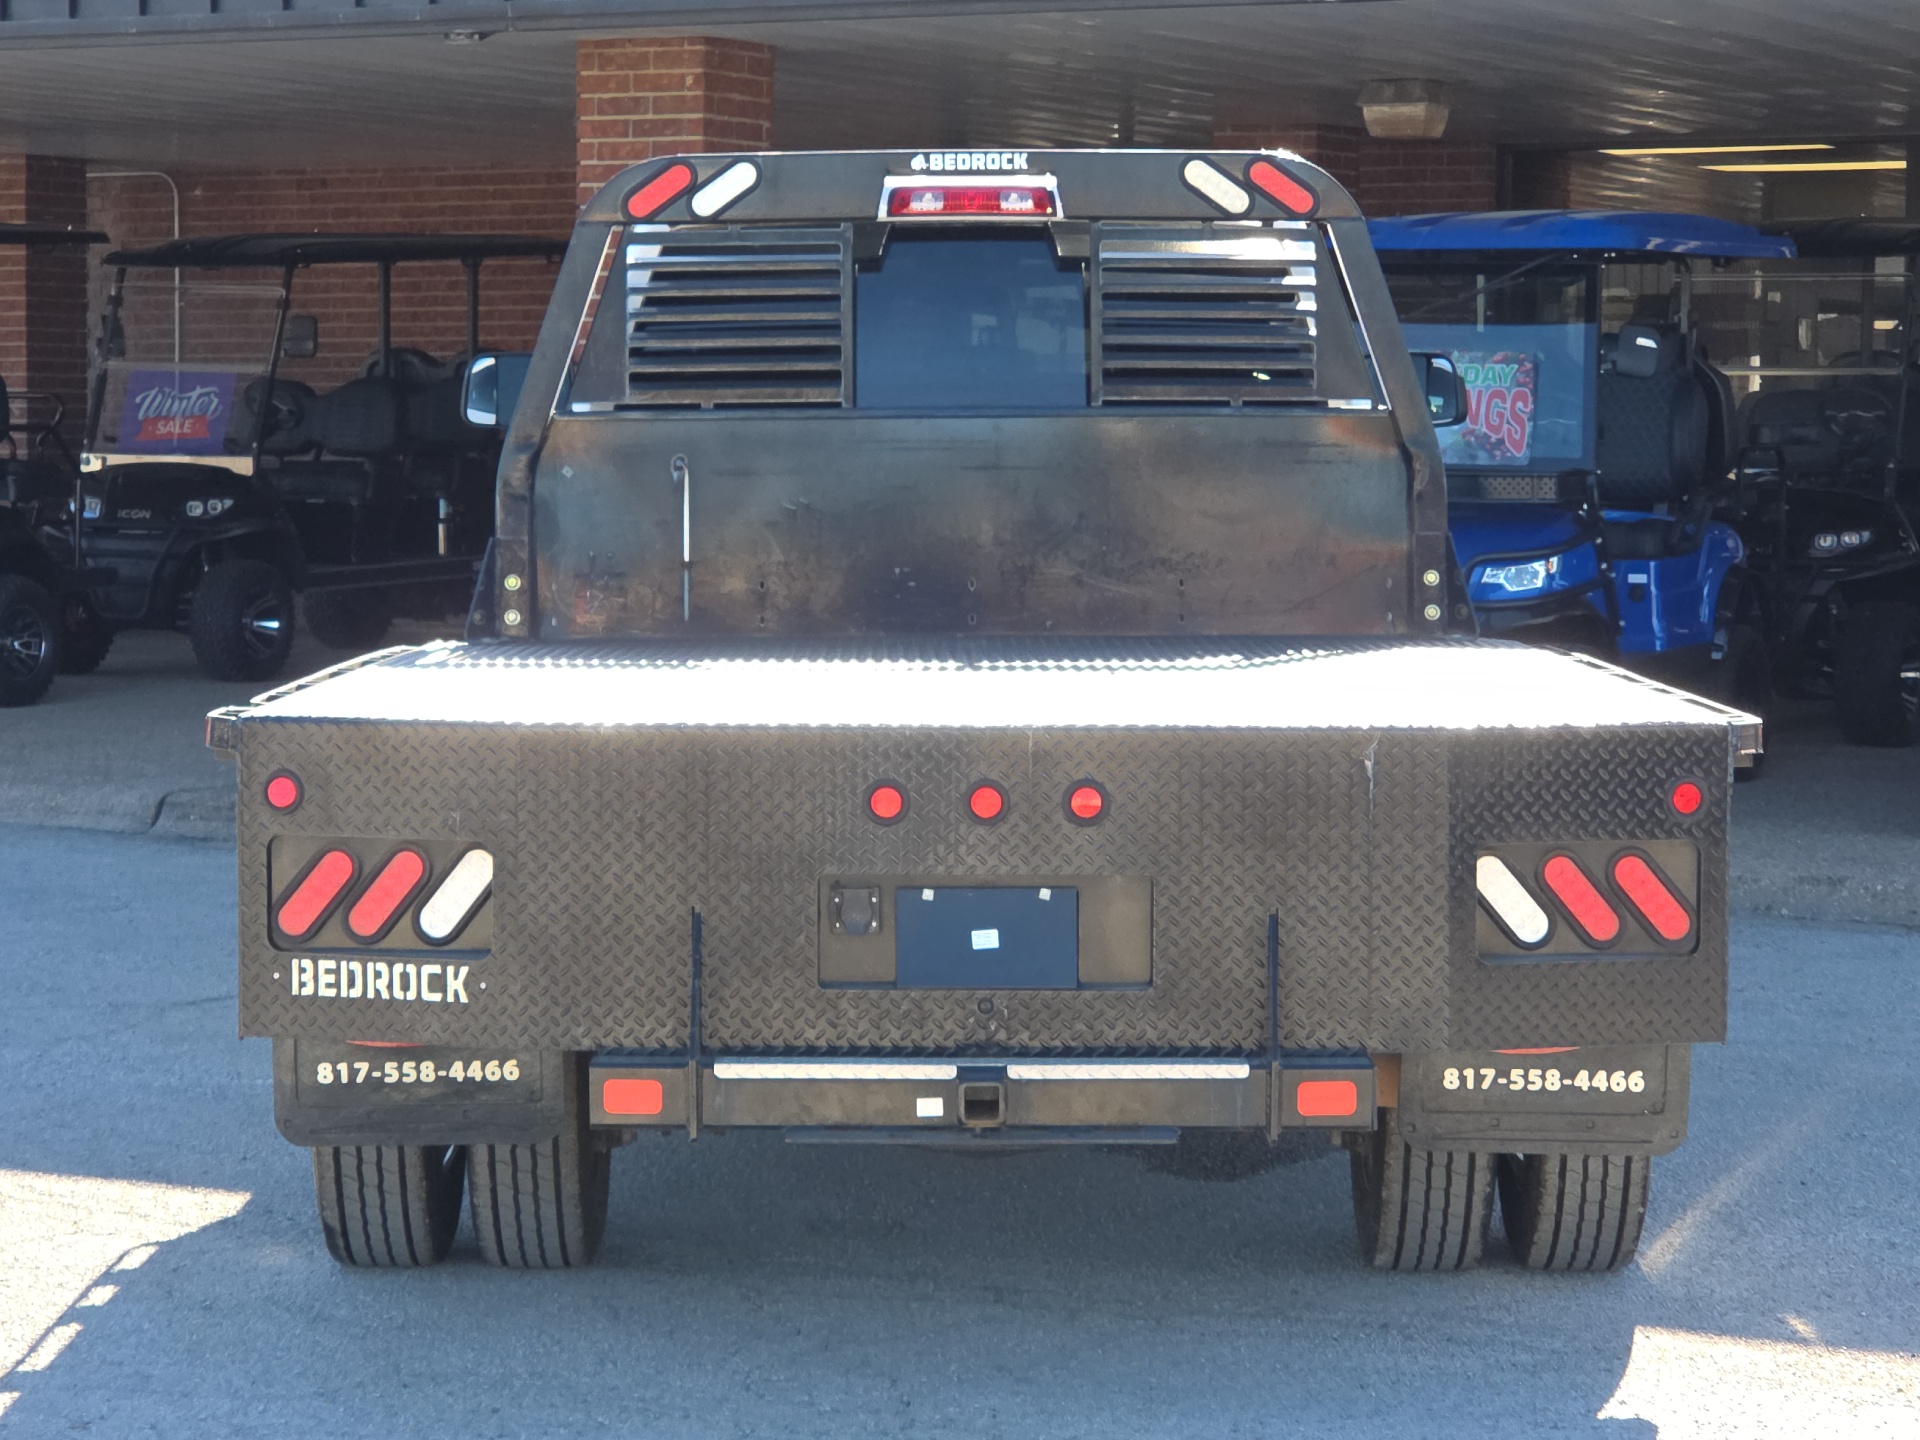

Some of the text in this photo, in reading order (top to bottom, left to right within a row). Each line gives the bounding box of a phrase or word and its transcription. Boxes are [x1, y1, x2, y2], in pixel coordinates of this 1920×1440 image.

[929, 153, 1028, 171] BEDROCK
[1463, 363, 1518, 386] DAY
[135, 385, 222, 421] Winter
[156, 419, 193, 435] SALE
[1466, 388, 1530, 457] NGS
[117, 509, 151, 519] ICON
[291, 958, 469, 1003] BEDROCK
[316, 1059, 520, 1084] 817-558-4466
[1442, 1067, 1645, 1093] 817-558-4466
